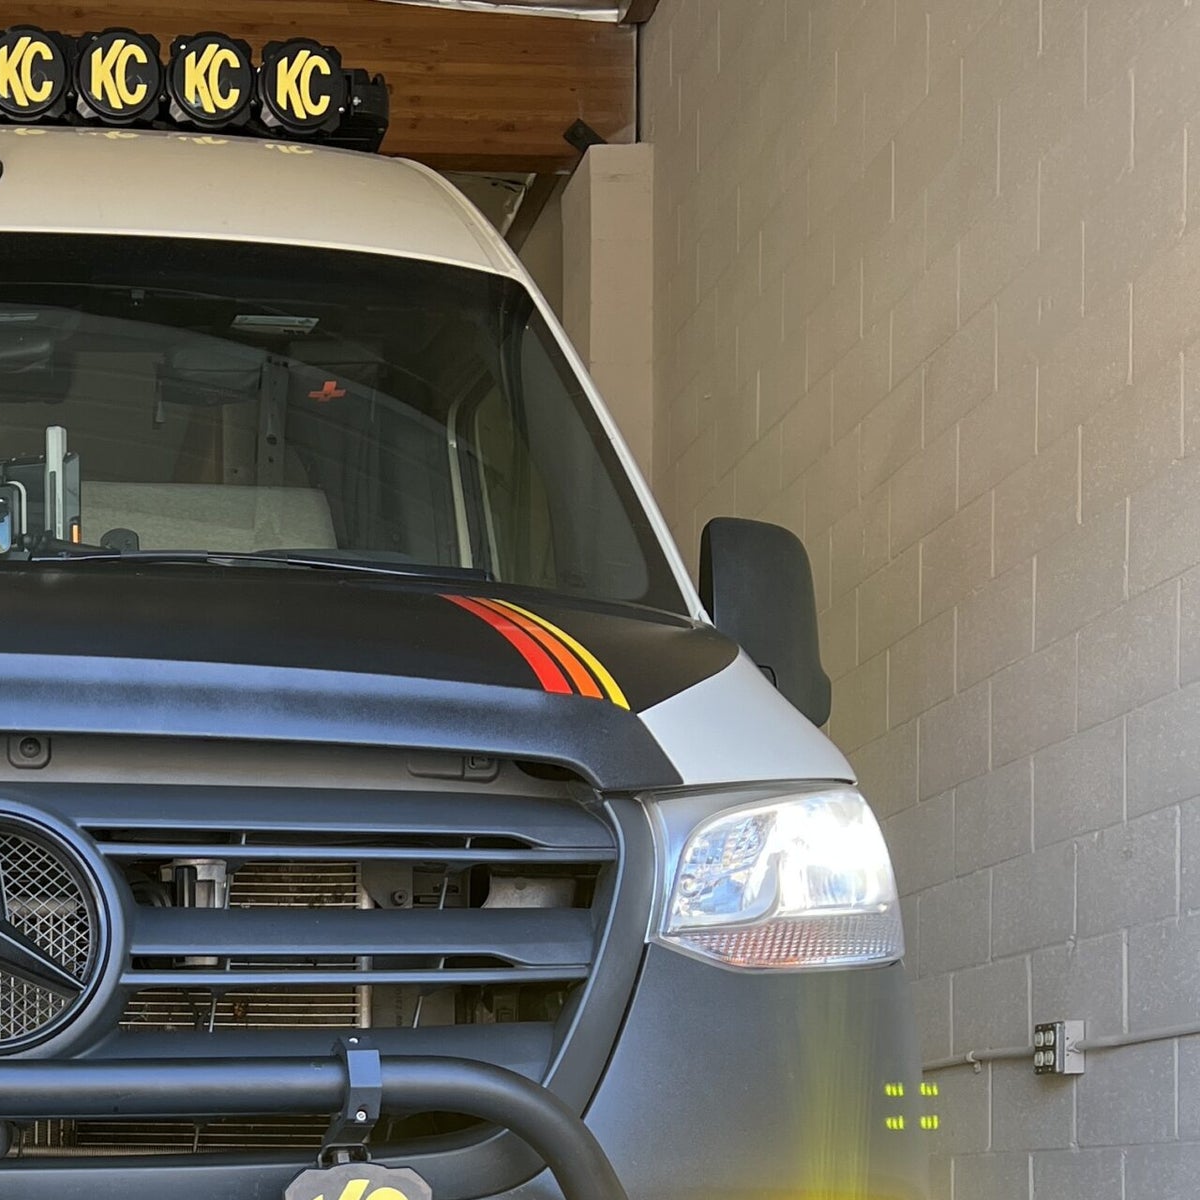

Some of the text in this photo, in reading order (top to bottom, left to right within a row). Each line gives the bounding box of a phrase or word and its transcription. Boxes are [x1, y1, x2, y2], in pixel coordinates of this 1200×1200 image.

[91, 40, 147, 109] KC
[185, 44, 240, 113] KC
[277, 50, 330, 119] KC
